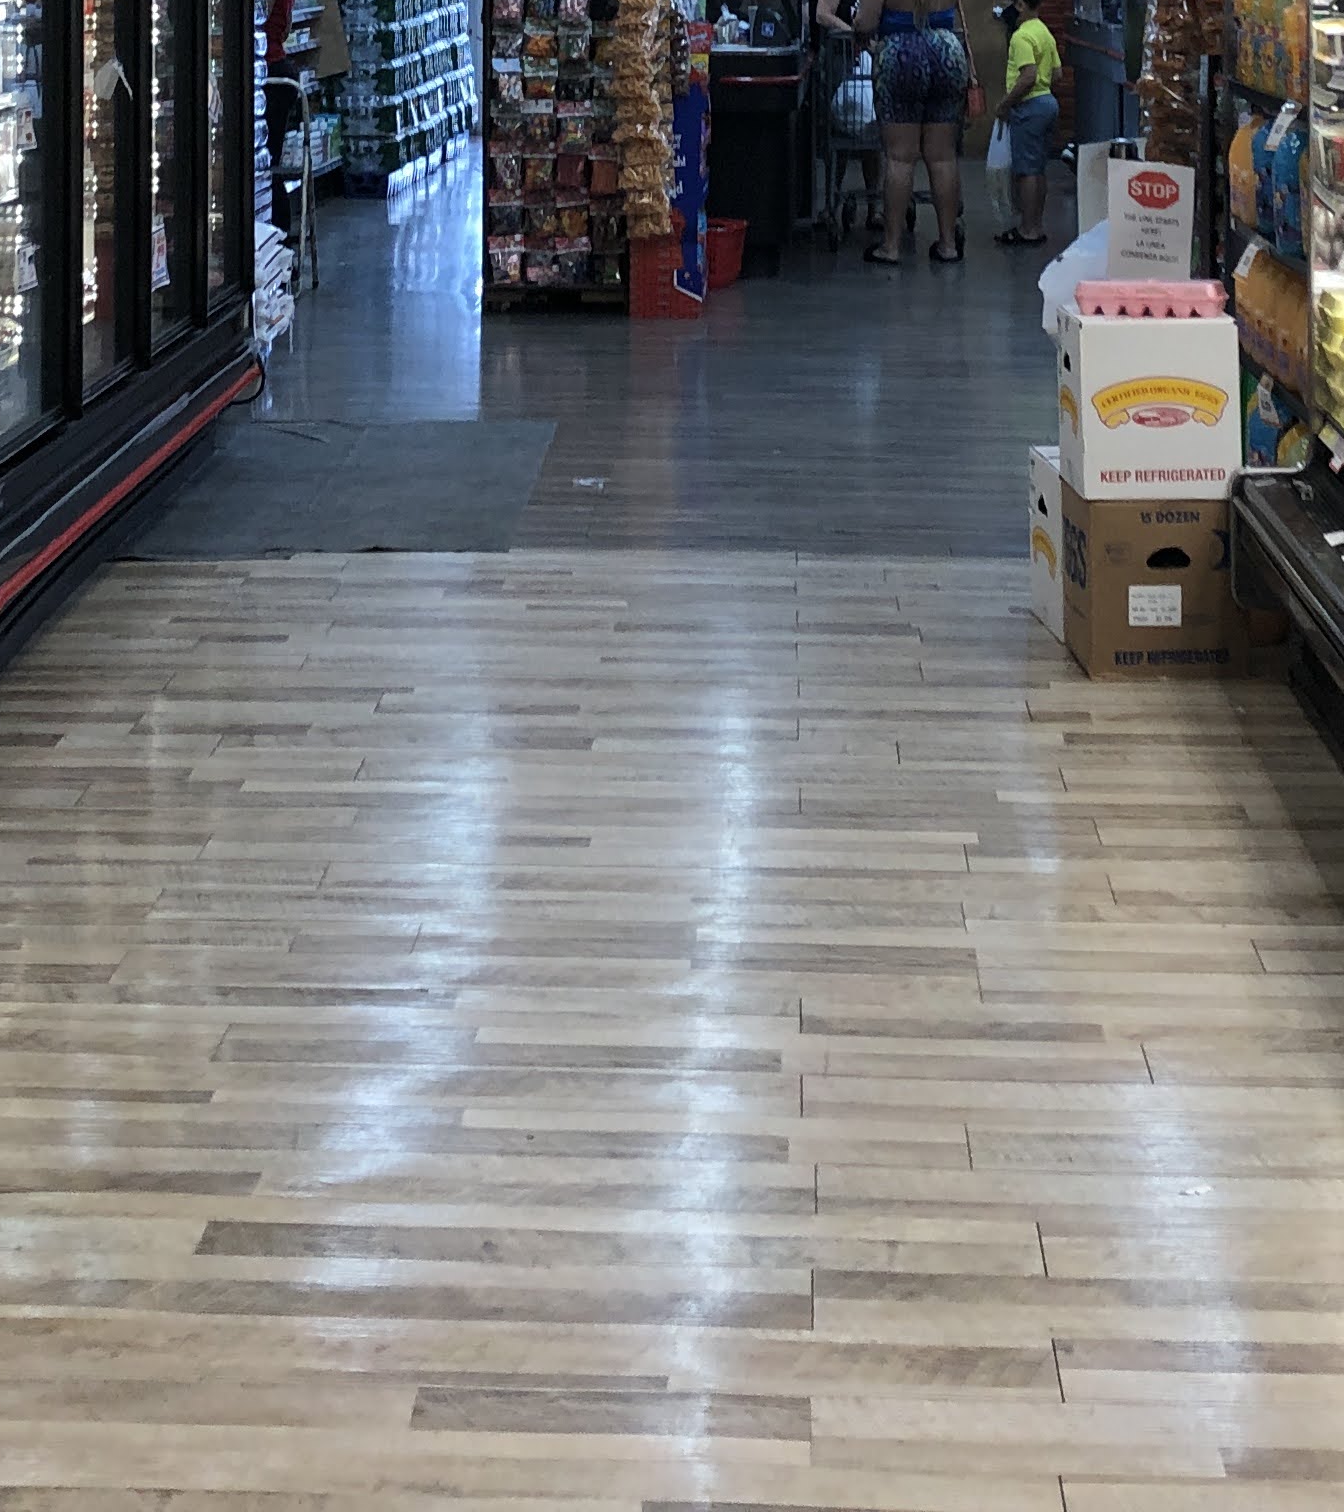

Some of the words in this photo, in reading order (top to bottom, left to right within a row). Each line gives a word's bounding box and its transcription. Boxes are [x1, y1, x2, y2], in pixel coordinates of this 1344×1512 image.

[1130, 179, 1177, 199] STOP
[1100, 469, 1132, 483] KEEP
[1134, 467, 1227, 483] REFRIGERATED
[1156, 510, 1201, 524] DOZEN
